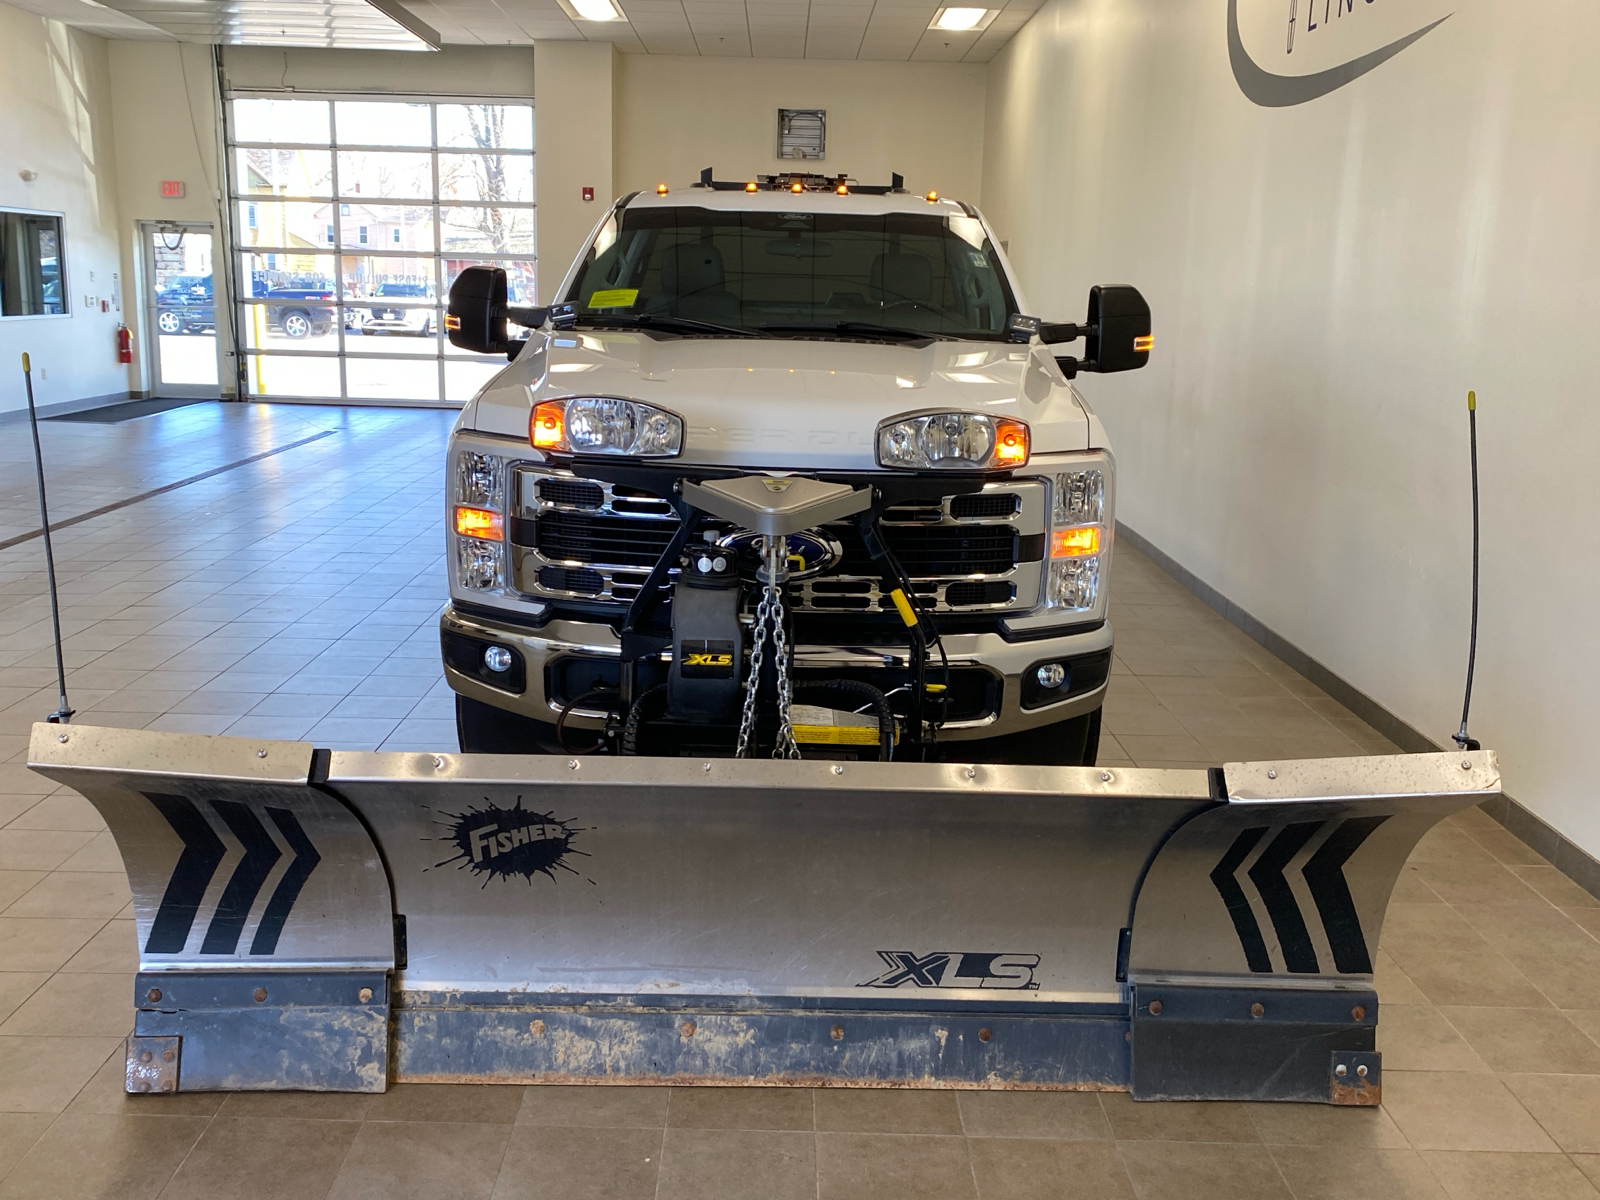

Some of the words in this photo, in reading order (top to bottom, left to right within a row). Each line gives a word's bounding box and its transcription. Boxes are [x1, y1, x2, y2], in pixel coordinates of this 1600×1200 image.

[162, 181, 180, 196] EXIT
[683, 653, 732, 666] XLS
[469, 823, 569, 863] FISHER
[855, 951, 1041, 990] XLS
